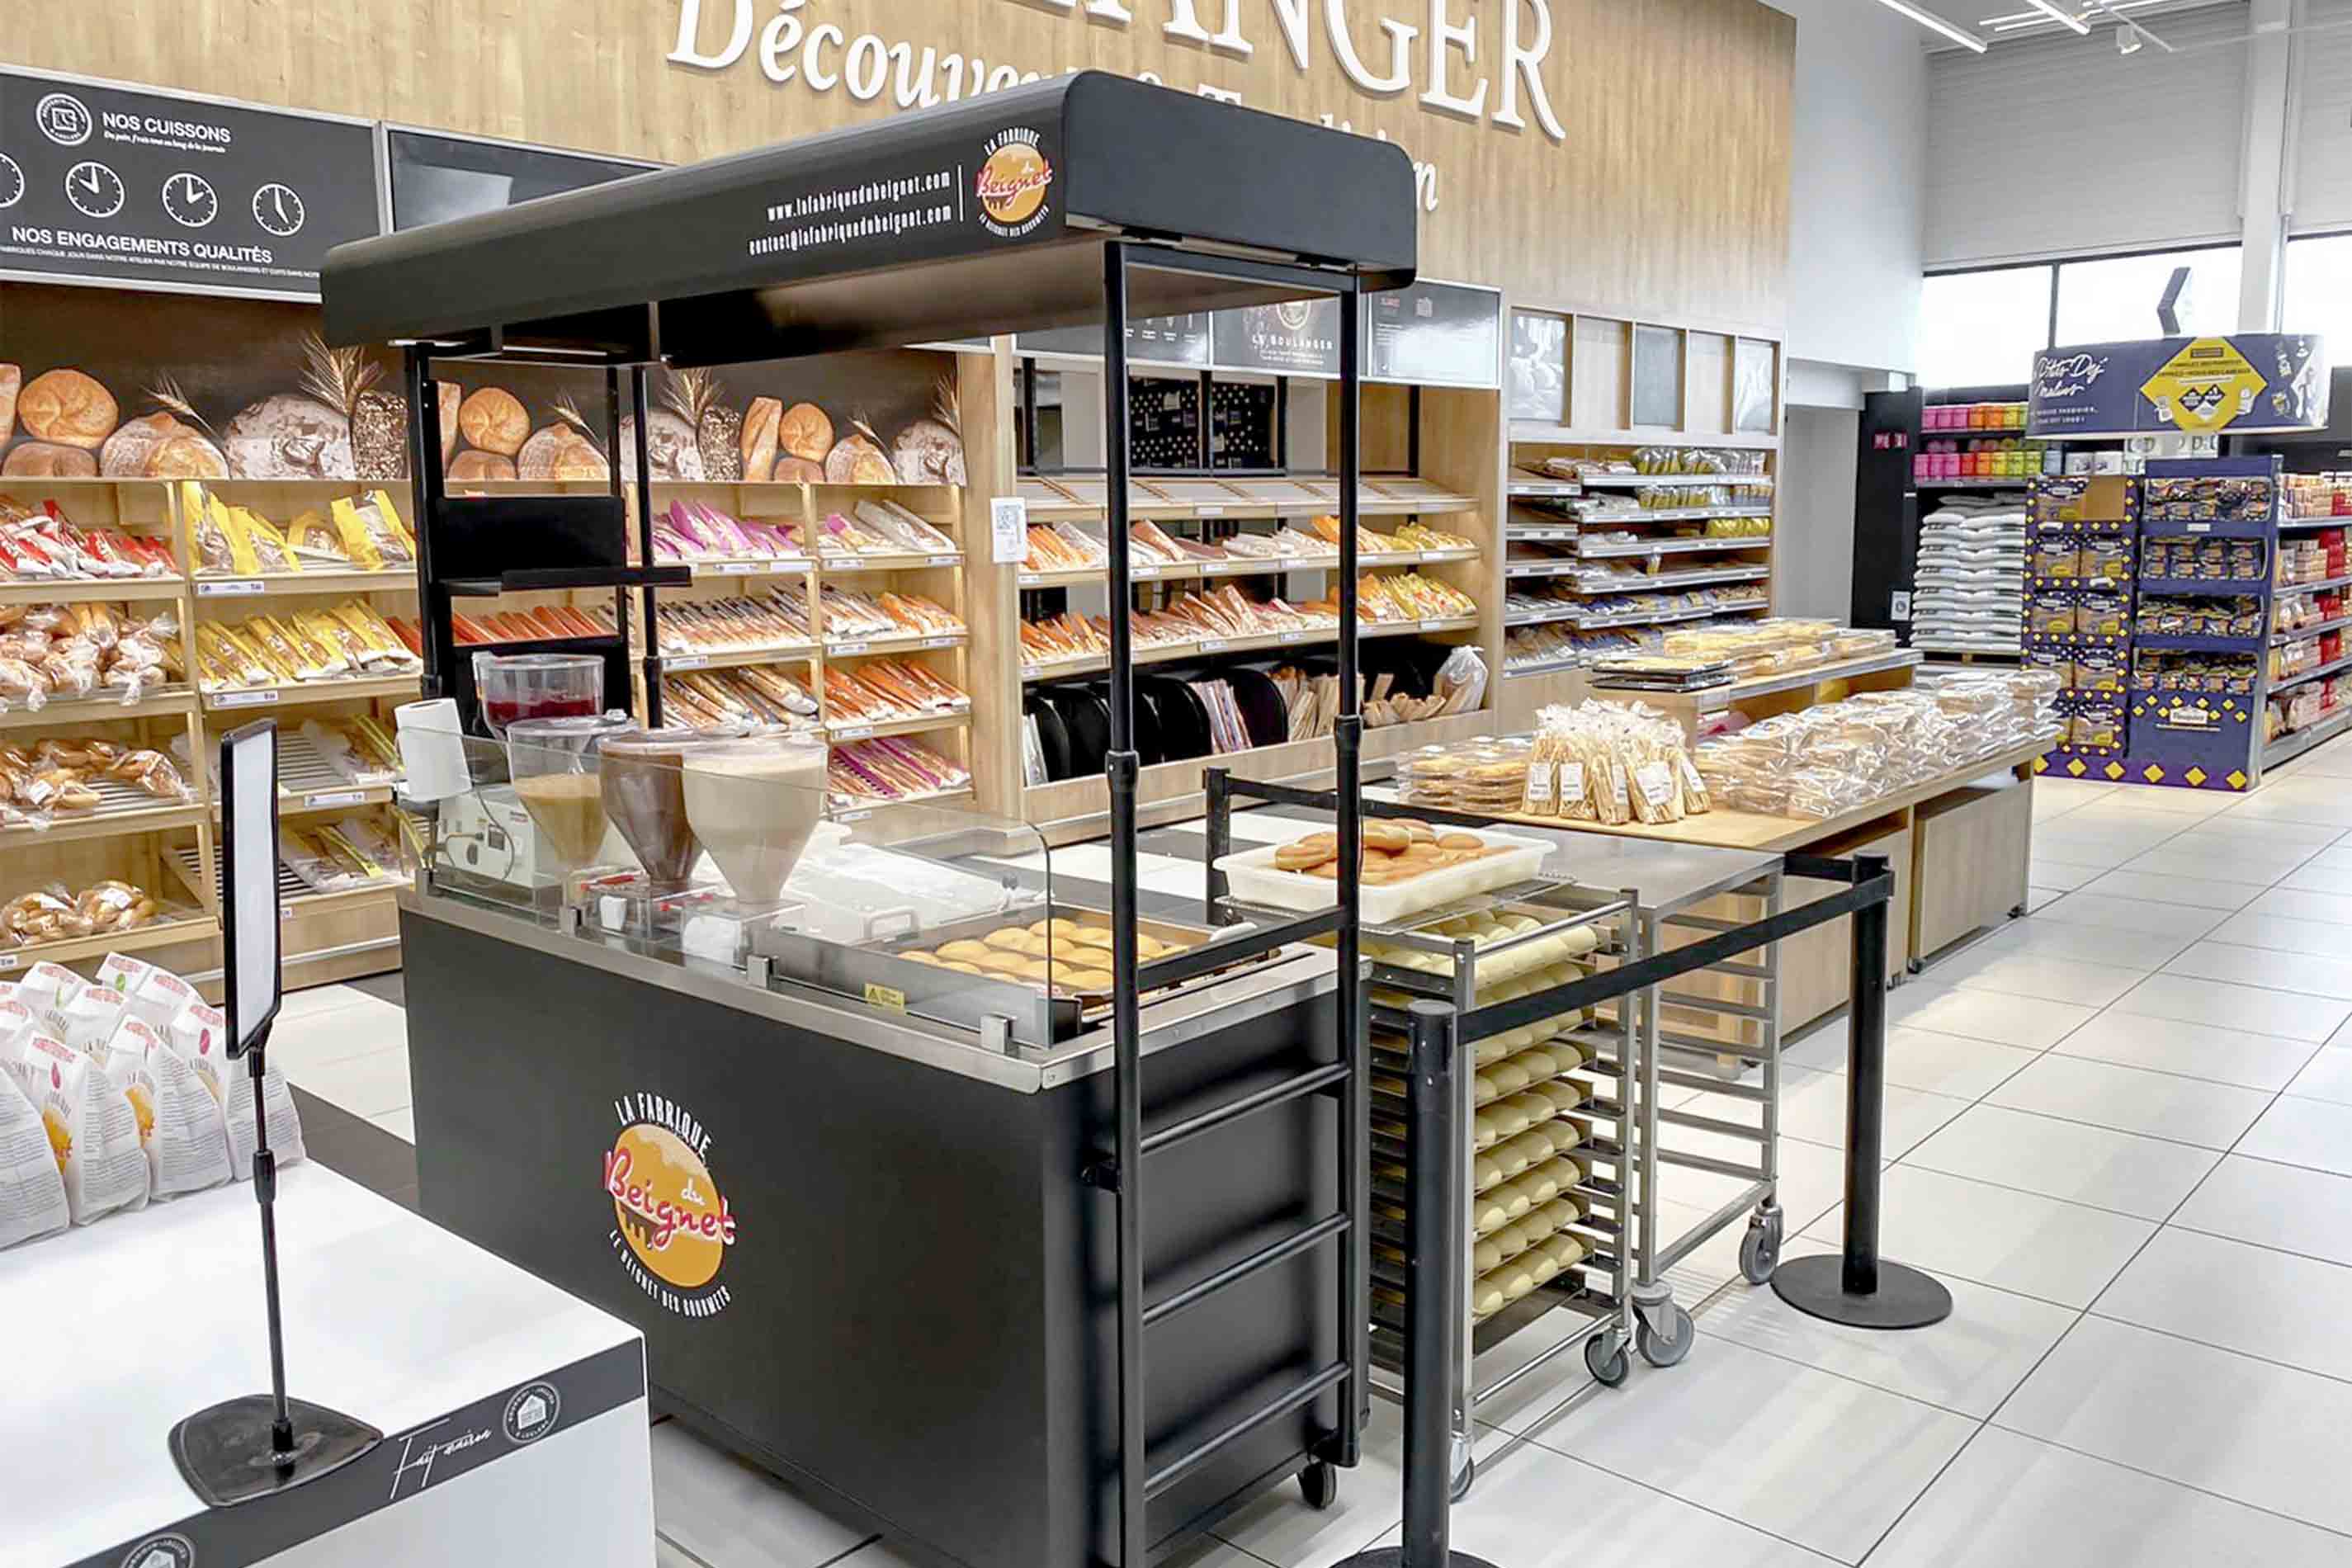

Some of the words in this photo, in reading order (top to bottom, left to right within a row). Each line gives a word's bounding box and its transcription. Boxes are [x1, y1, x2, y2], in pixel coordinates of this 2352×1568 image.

[102, 111, 140, 130] NOS
[144, 117, 231, 143] CUISSONS
[976, 158, 1053, 210] Beignet
[12, 226, 52, 243] NOS
[57, 230, 189, 257] ENGAGEMENTS
[193, 243, 272, 263] QUALITÉS
[615, 1095, 635, 1126] LA
[636, 1092, 713, 1159] FABRIQUE
[604, 1148, 736, 1251] Beignet
